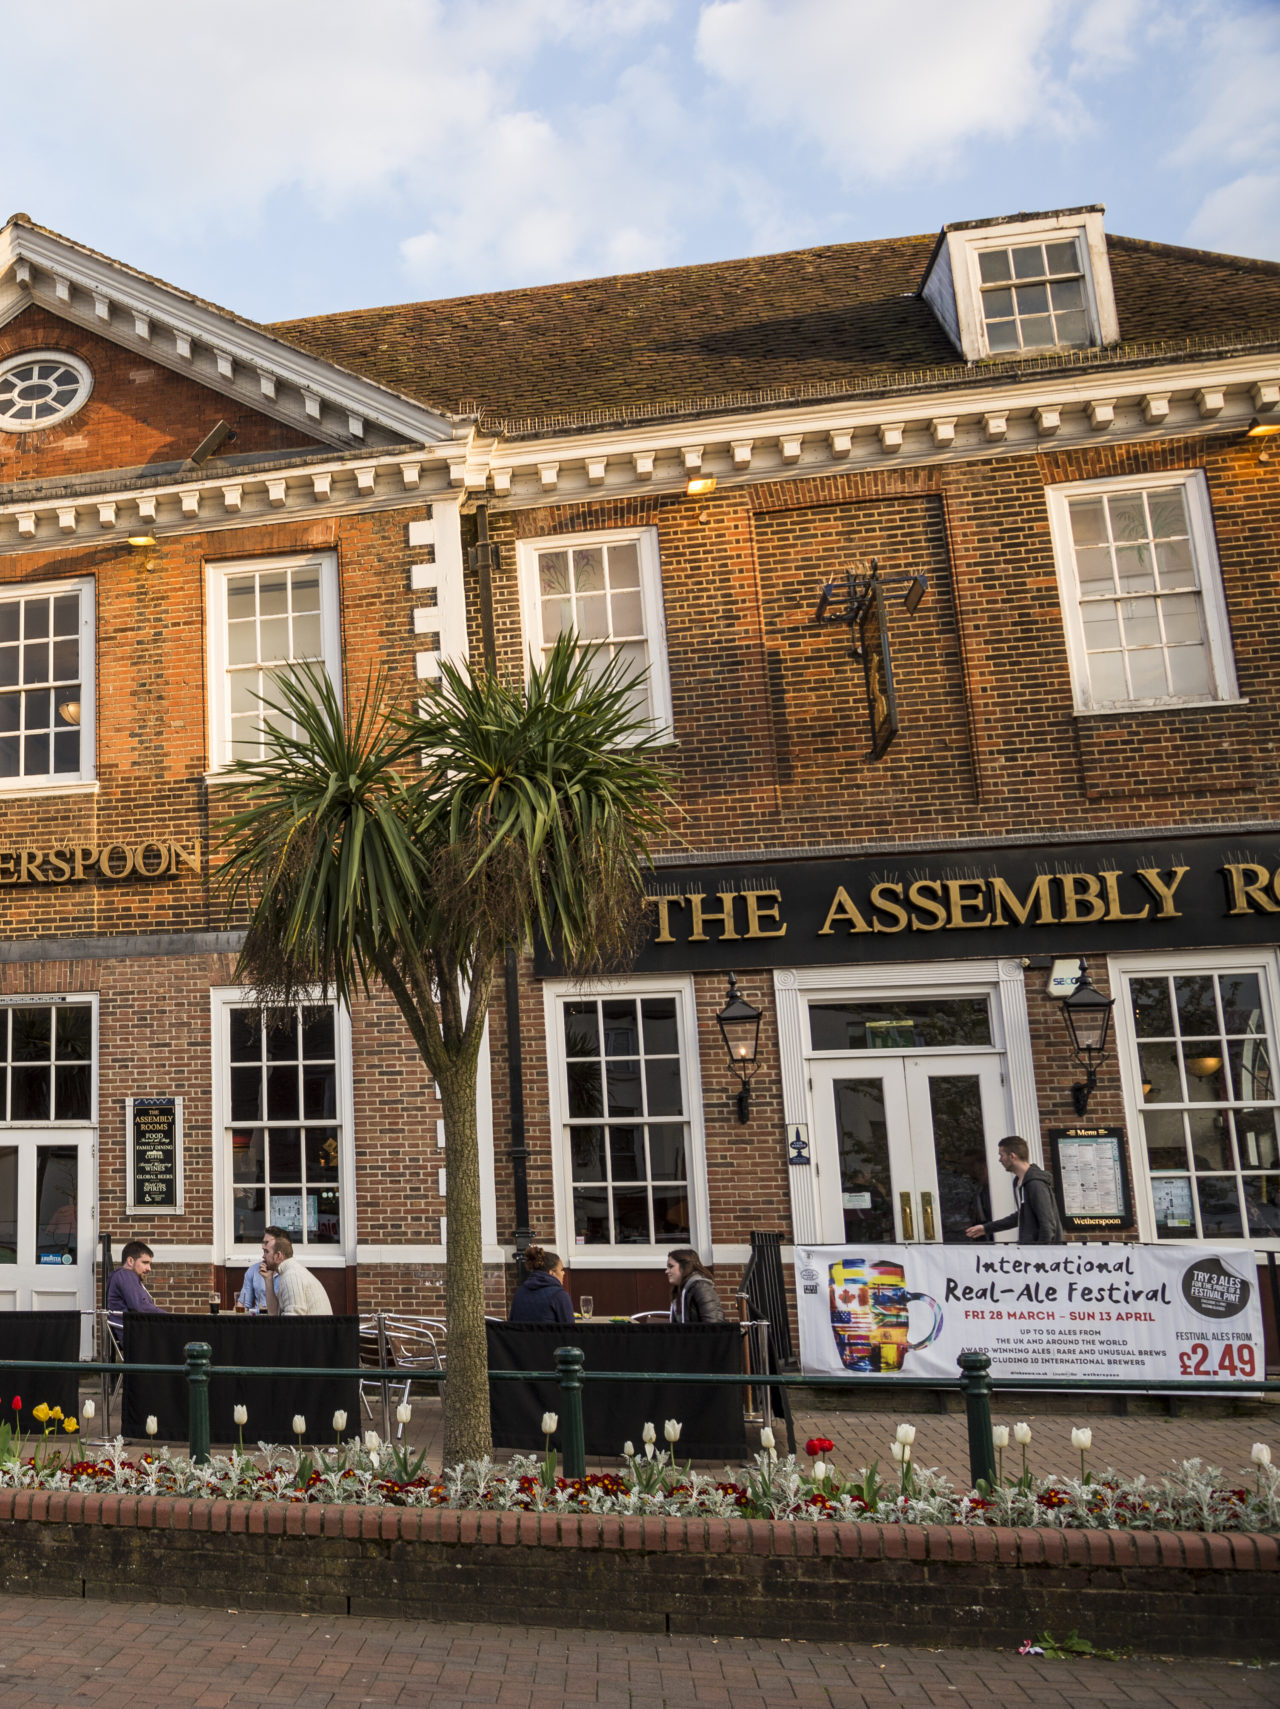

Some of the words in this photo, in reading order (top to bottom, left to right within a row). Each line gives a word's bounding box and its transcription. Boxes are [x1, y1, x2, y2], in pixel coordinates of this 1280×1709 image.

[647, 888, 787, 944] THE
[818, 866, 1190, 936] ASSEMBLY
[135, 1115, 173, 1123] ASSEMBLY
[140, 1123, 168, 1131] ROOMS
[1073, 1217, 1121, 1226] Wetherspoon
[976, 1255, 1134, 1275] International
[1193, 1270, 1210, 1283] TRY
[1211, 1274, 1218, 1284] 3
[1219, 1275, 1241, 1289] ALES
[945, 1277, 1058, 1304] Real-Ale
[1068, 1281, 1172, 1305] Festival
[1191, 1280, 1202, 1288] FOR
[1203, 1282, 1212, 1290] THE
[1213, 1284, 1227, 1292] PRICE
[1191, 1286, 1222, 1300] FESTIVAL
[1223, 1292, 1240, 1304] PINT
[964, 1310, 985, 1320] FRI
[989, 1310, 1003, 1320] 28
[1007, 1311, 1055, 1321] MARCH
[1069, 1311, 1094, 1321] SUN
[1099, 1311, 1112, 1321] 13
[1116, 1312, 1156, 1322] APRIL
[1175, 1331, 1210, 1341] FESTIVAL
[1211, 1332, 1230, 1341] ALES
[1231, 1332, 1252, 1341] FROM
